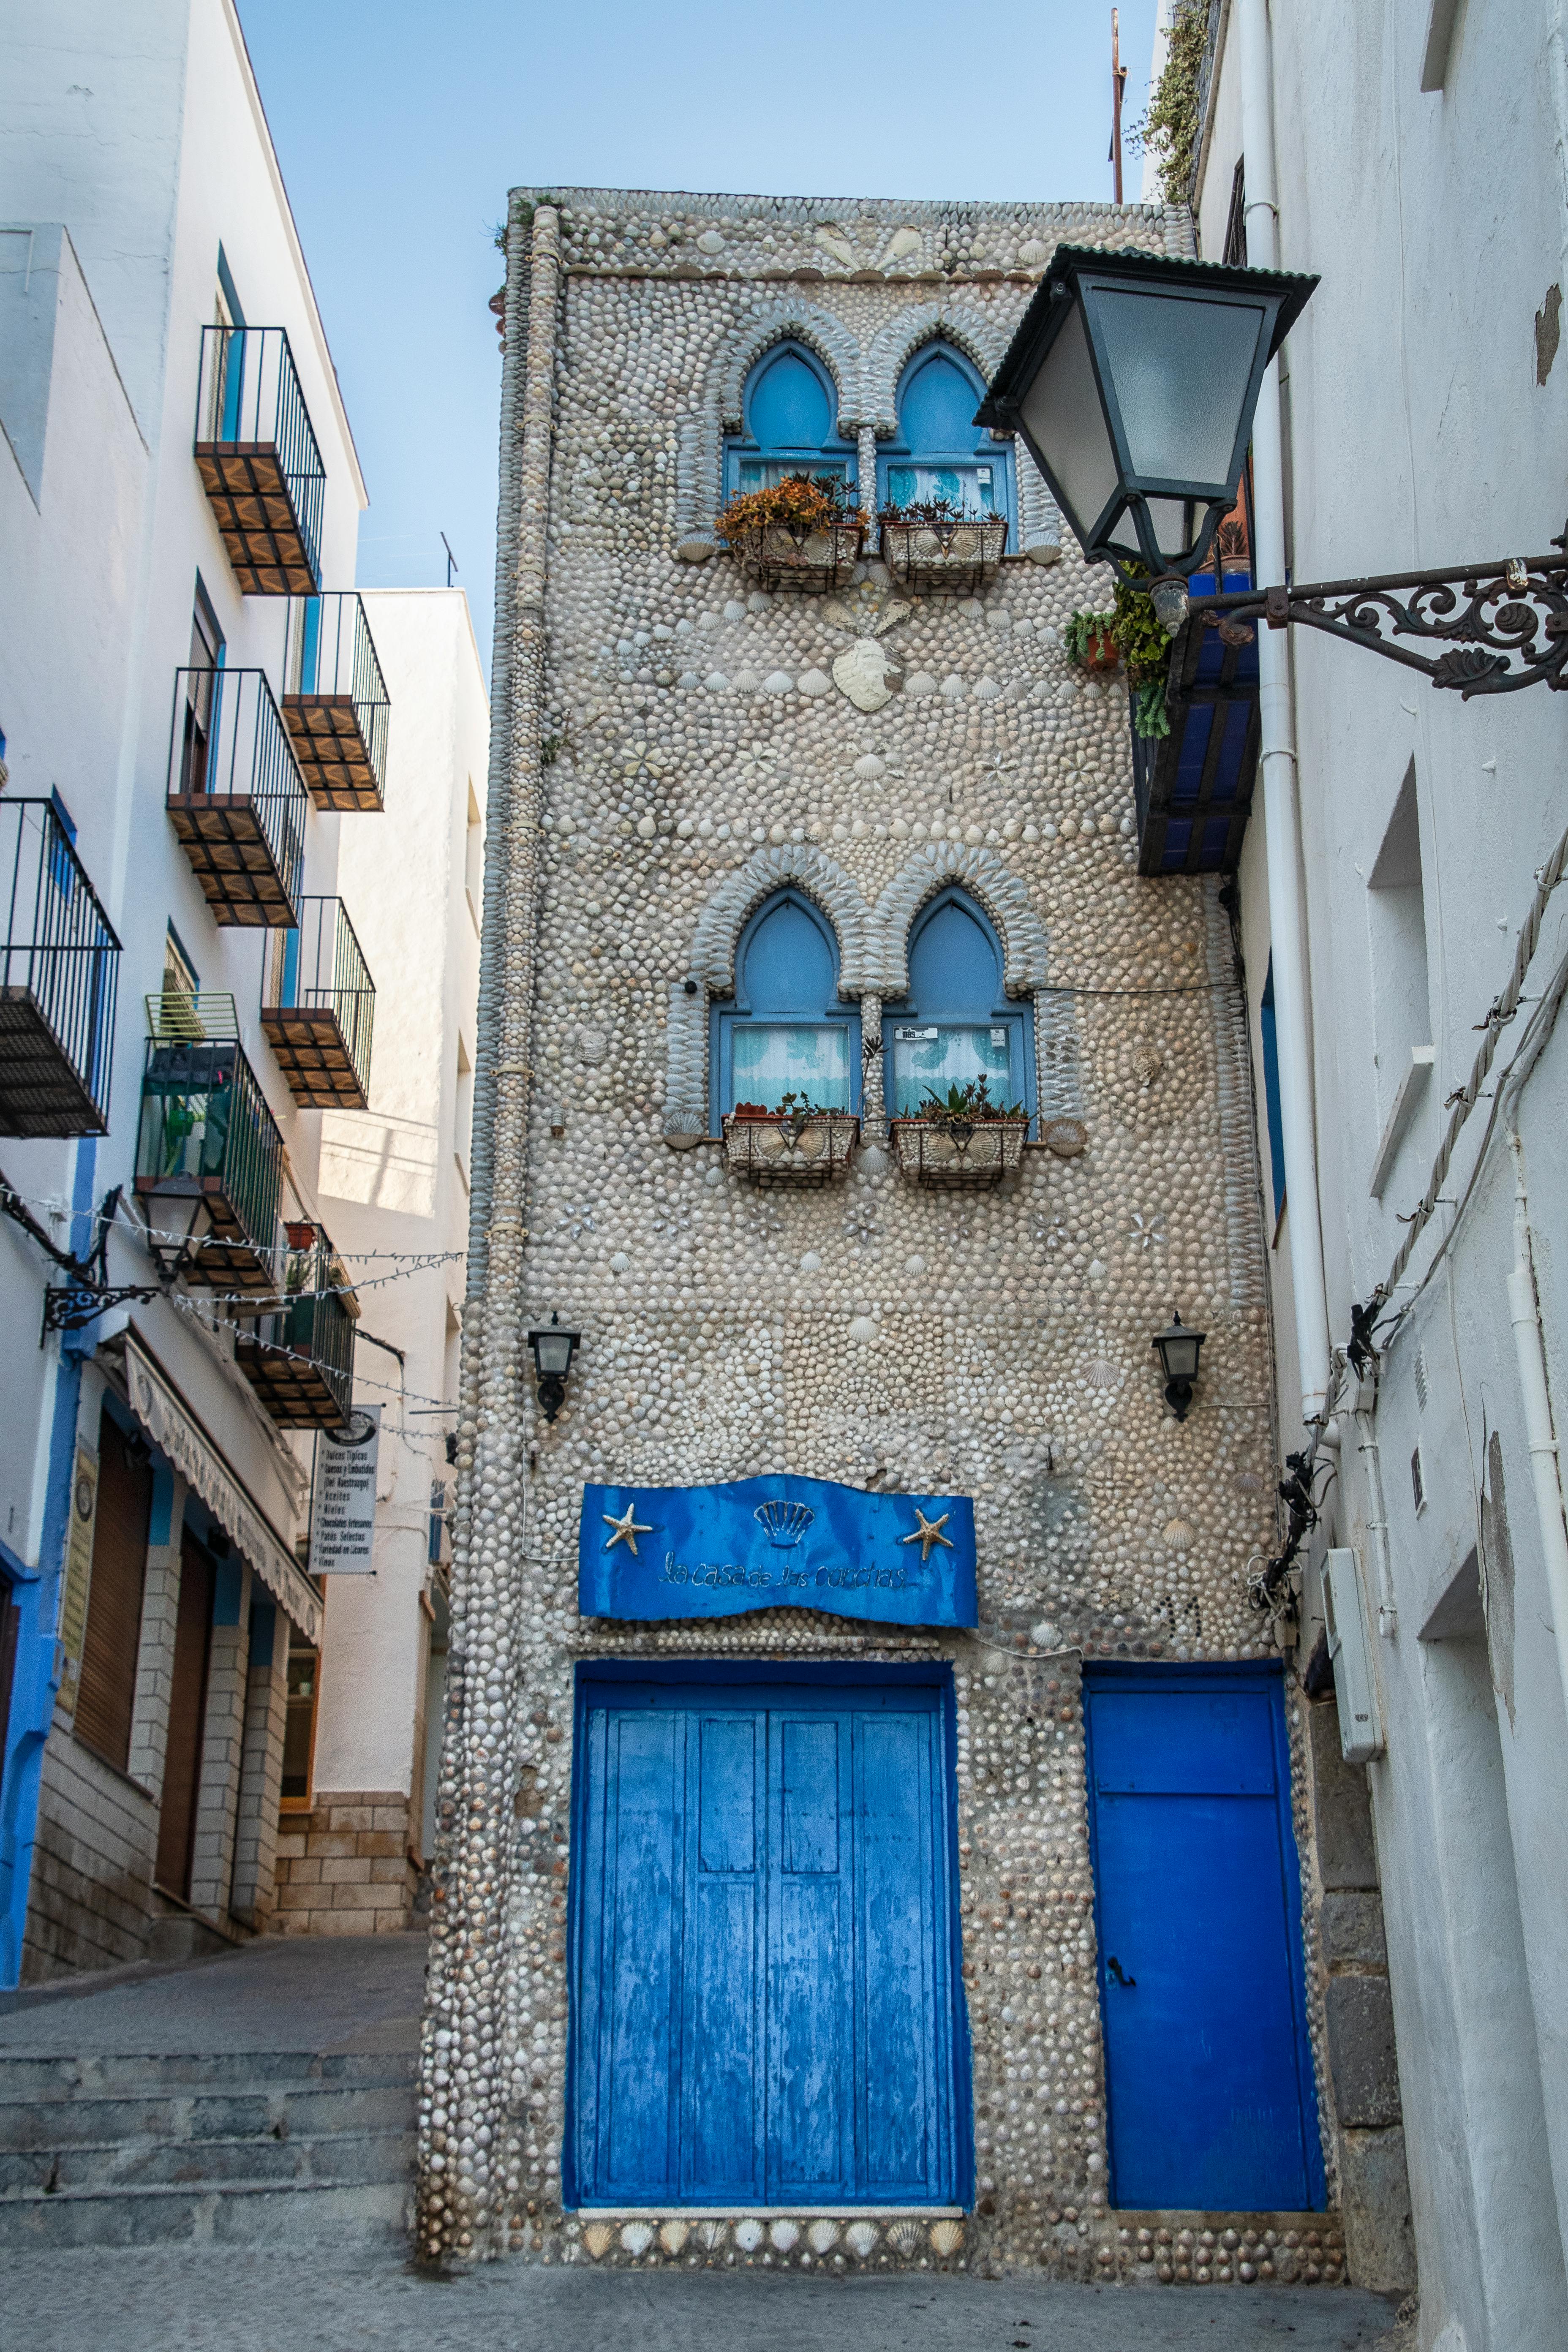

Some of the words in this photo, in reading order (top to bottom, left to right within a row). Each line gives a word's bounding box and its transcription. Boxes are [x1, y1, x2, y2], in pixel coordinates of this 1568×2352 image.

[325, 1463, 342, 1474] Quesos
[343, 1466, 347, 1477] y
[348, 1463, 374, 1474] Embutidos
[325, 1491, 350, 1501] Aceites
[324, 1503, 345, 1515] Mieles
[321, 1517, 346, 1528] Chocolates
[348, 1517, 372, 1528] Artesanos
[340, 1531, 365, 1542] Selectos
[319, 1544, 341, 1554] Variedad
[342, 1546, 349, 1554] en
[318, 1555, 335, 1567] Vinos
[658, 1551, 687, 1584] la
[748, 1565, 772, 1587] de
[776, 1565, 809, 1587] las
